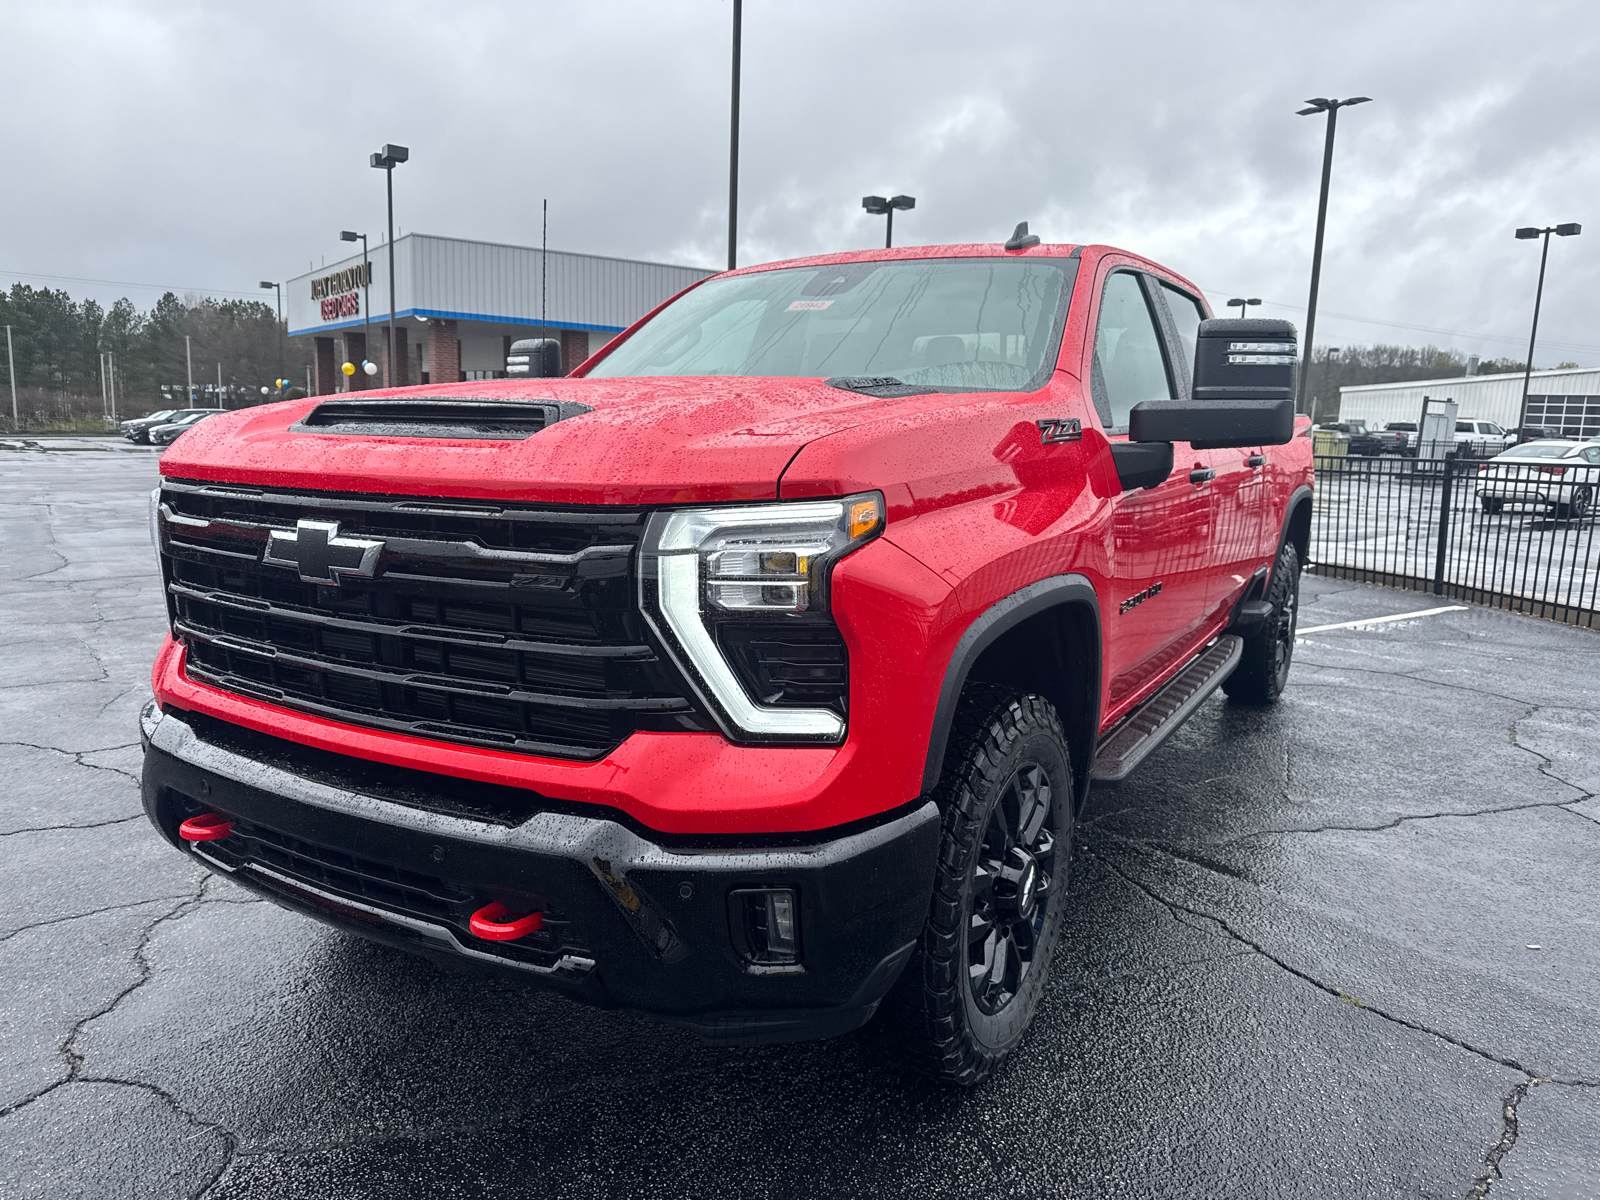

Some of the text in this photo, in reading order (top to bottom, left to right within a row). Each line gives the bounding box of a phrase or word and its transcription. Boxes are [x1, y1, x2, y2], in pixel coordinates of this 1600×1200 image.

[320, 292, 360, 320] USED CARS
[1037, 418, 1083, 444] Z71
[1147, 581, 1162, 599] HD
